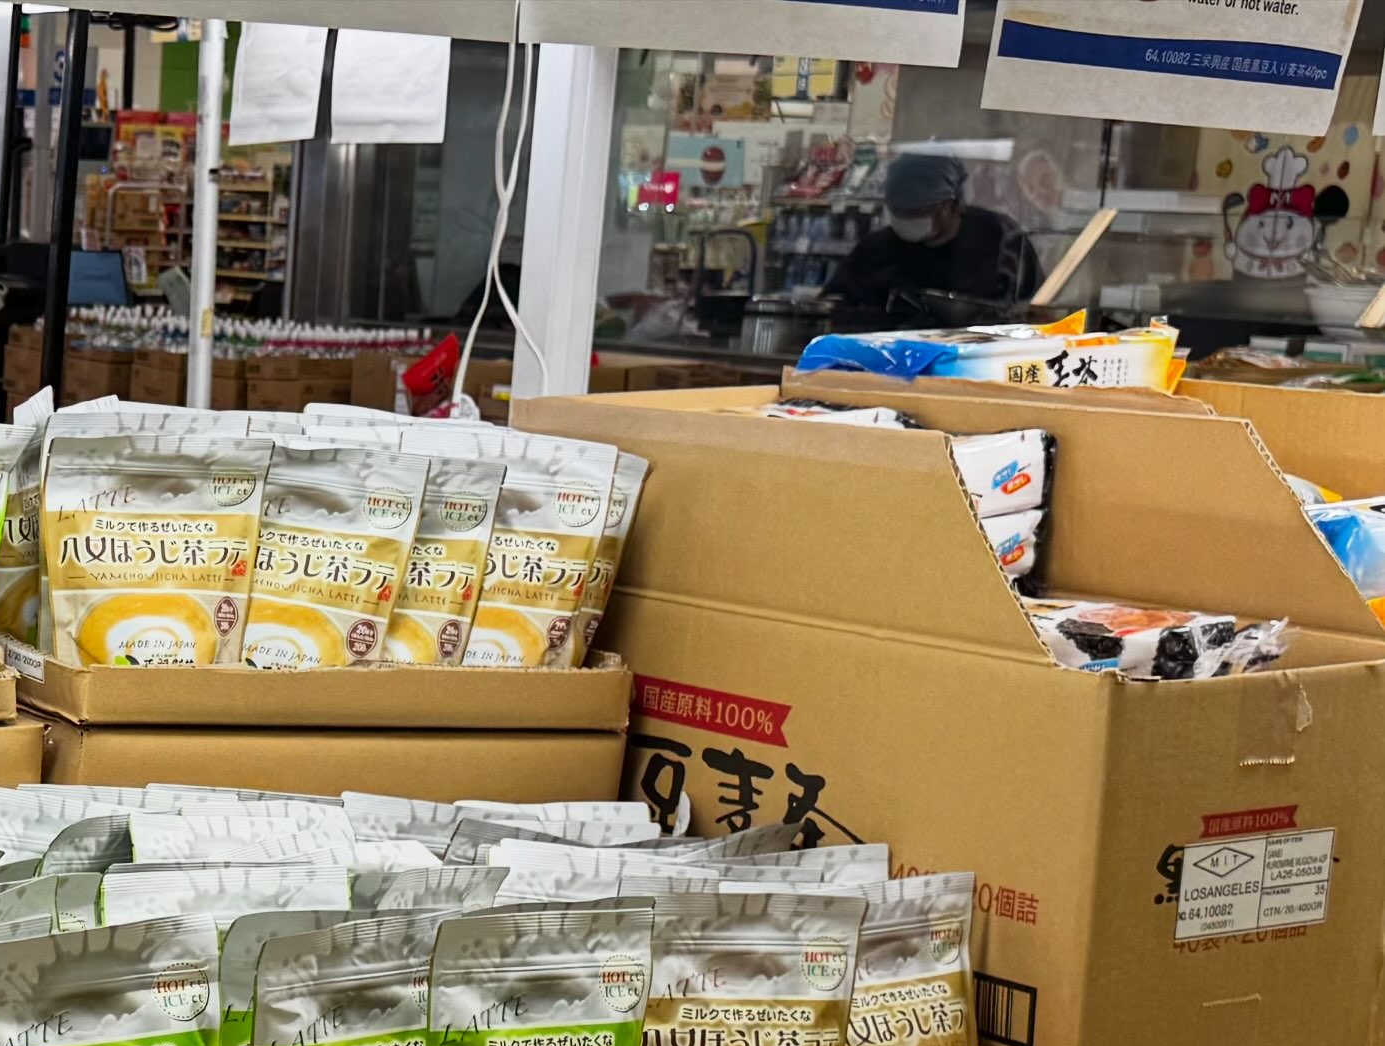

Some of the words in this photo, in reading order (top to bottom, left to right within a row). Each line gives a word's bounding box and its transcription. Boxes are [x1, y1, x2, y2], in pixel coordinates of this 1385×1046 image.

[1264, 1, 1299, 16] water.
[1145, 49, 1190, 65] 64.10082
[1008, 365, 1041, 383] 国産
[96, 519, 214, 532] ミルクで作るぜいたくな
[61, 536, 247, 566] 八女ほうじ茶ラテ
[254, 546, 395, 590] ほうじ茶ラテ
[192, 574, 221, 582] LATTE
[642, 685, 774, 736] 国産原料100%
[1184, 880, 1260, 901] LOSANGELES
[1315, 885, 1325, 896] 35
[1189, 904, 1233, 920] 64.10082
